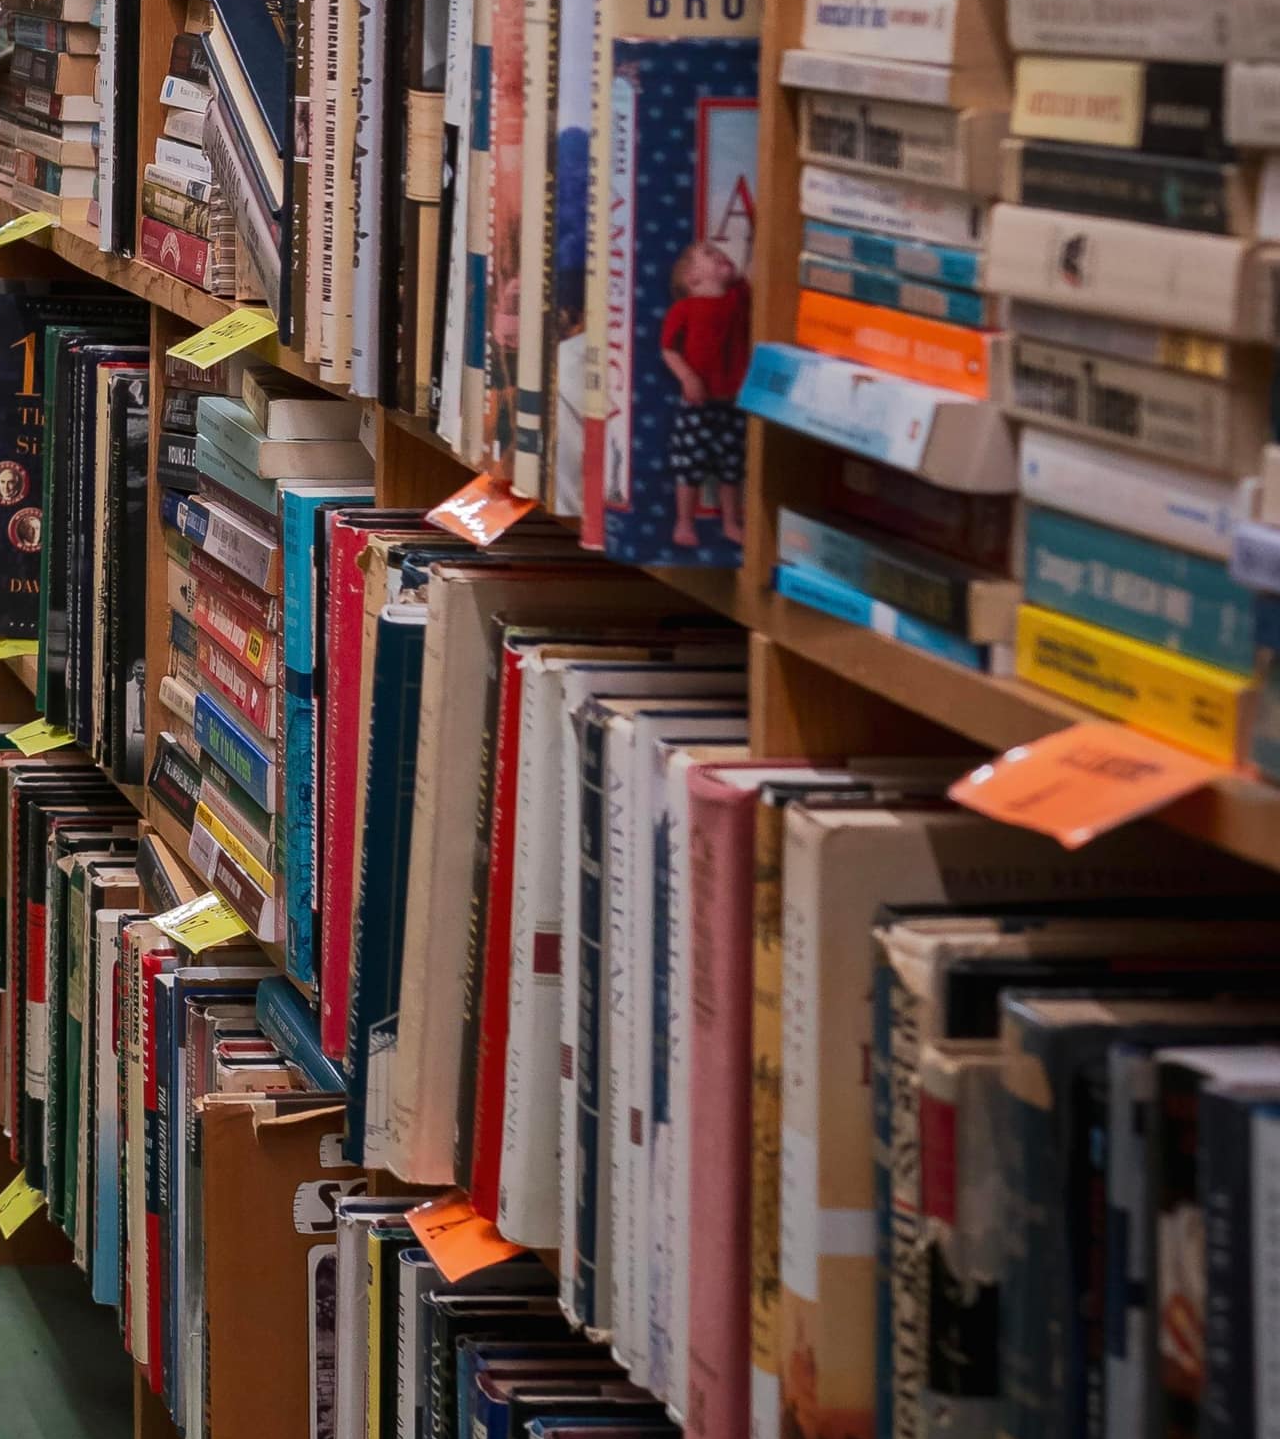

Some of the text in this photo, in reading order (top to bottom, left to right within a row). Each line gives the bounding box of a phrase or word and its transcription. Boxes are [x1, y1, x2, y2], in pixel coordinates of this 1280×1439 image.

[326, 98, 336, 123] THE
[325, 127, 336, 160] FOURTH
[325, 163, 335, 195] GREAT
[324, 197, 334, 243] WESTERN
[322, 248, 333, 303] RELIGION
[158, 1086, 169, 1205] THE VICTORIANS
